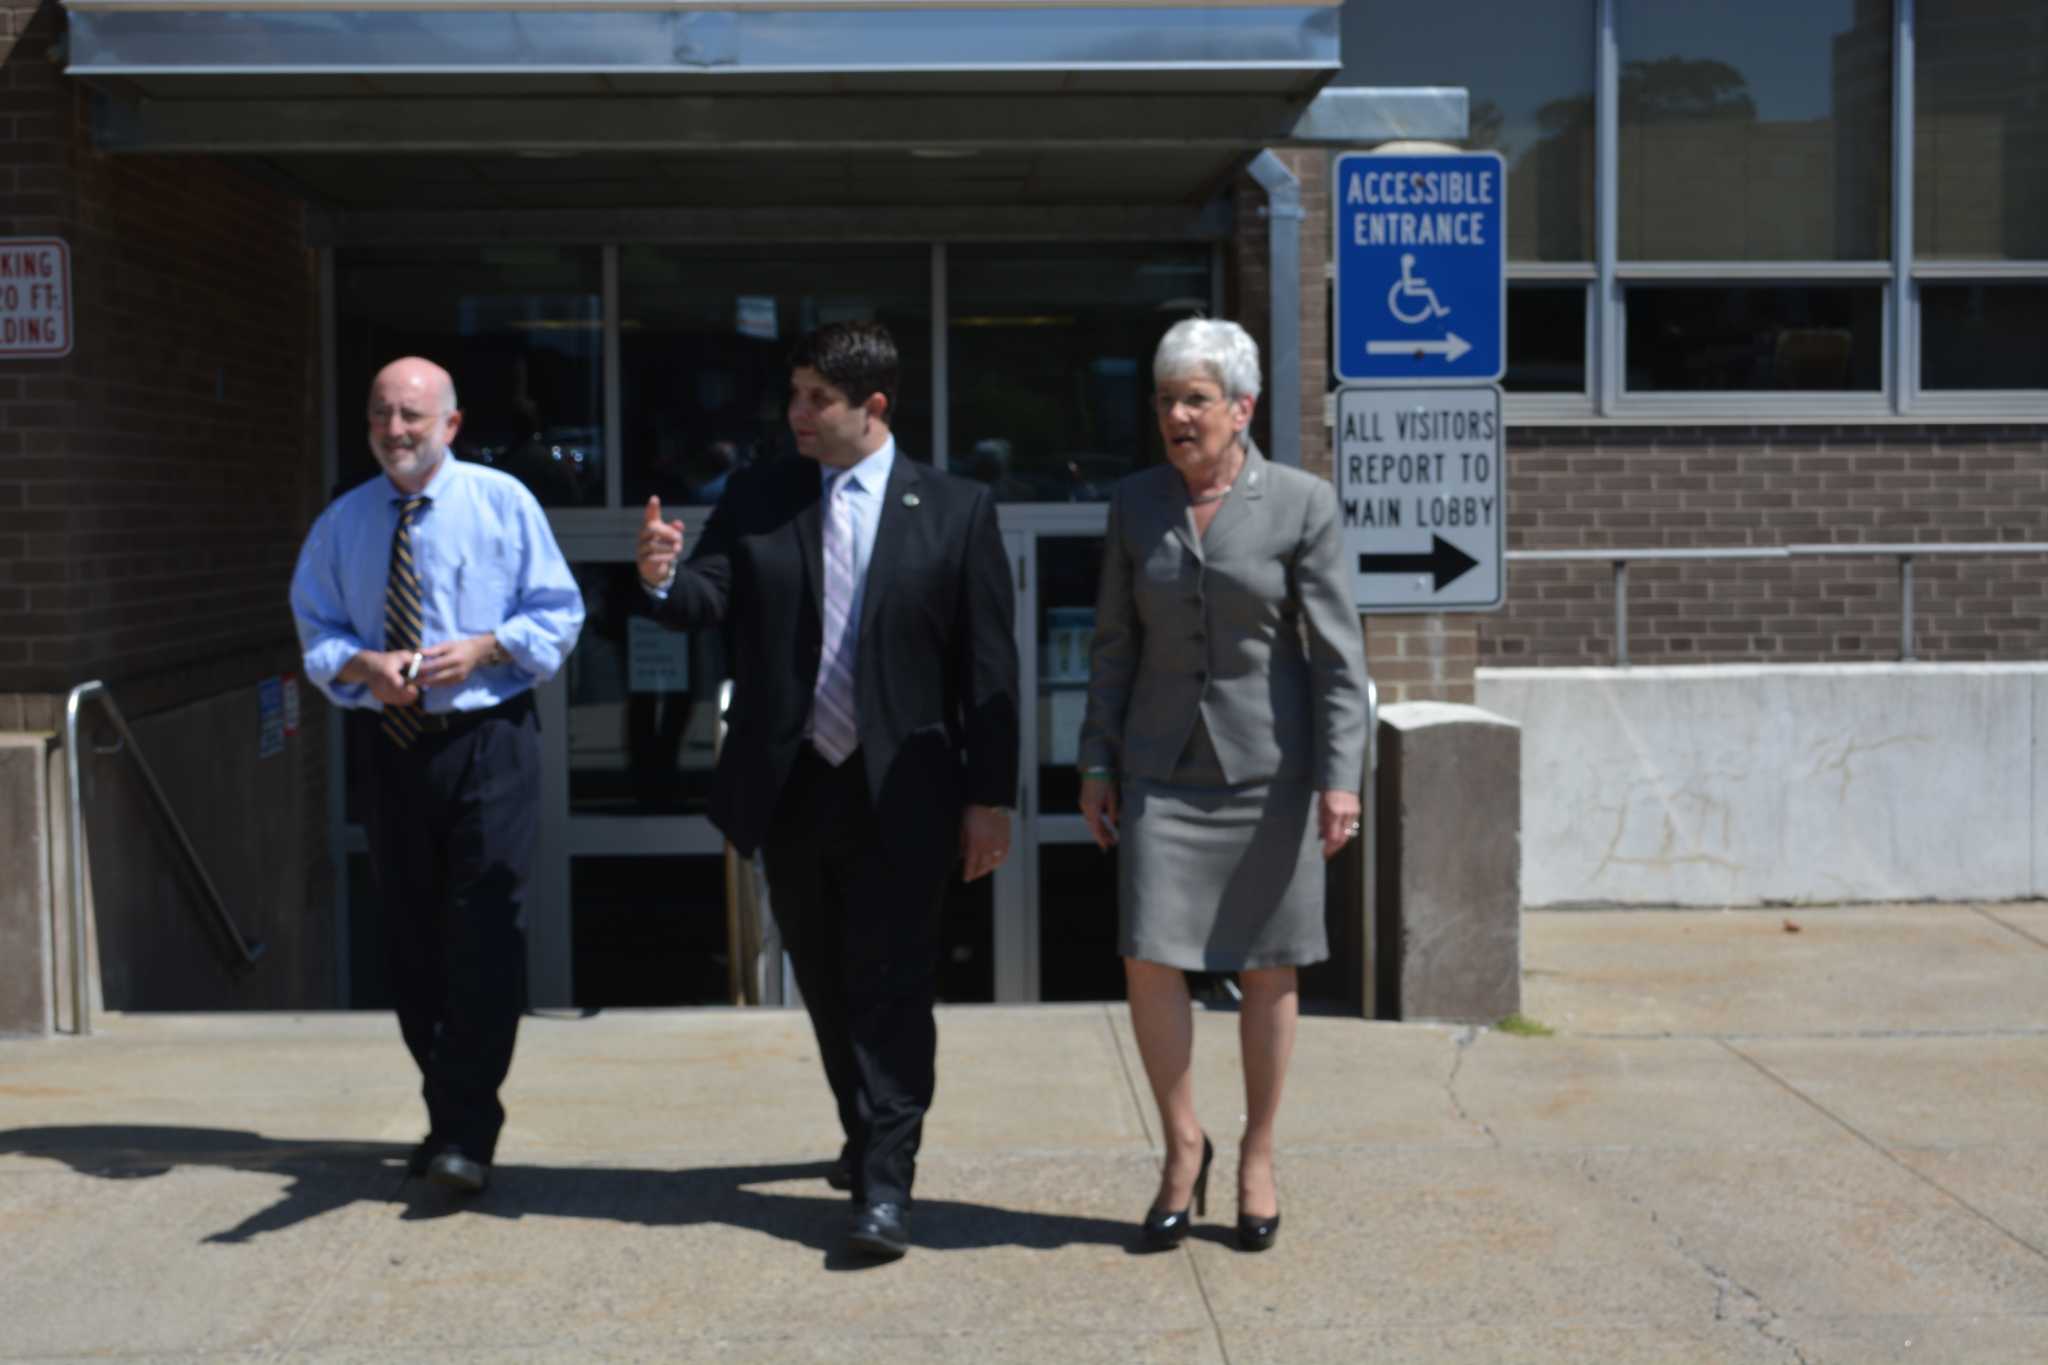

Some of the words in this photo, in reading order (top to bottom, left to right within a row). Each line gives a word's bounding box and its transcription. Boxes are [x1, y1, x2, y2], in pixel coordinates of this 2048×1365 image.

[1347, 171, 1494, 205] ACCESSIBLE
[1354, 212, 1485, 245] ENTRANCE
[0, 252, 53, 277] KING
[0, 284, 19, 312] 0
[0, 317, 56, 344] DING
[1343, 411, 1383, 443] ALL
[1395, 410, 1495, 441] VISITORS
[1348, 453, 1445, 485] REPORT
[1460, 452, 1490, 484] TO
[1342, 497, 1400, 528] MAIN
[1415, 495, 1494, 528] LOBBY
